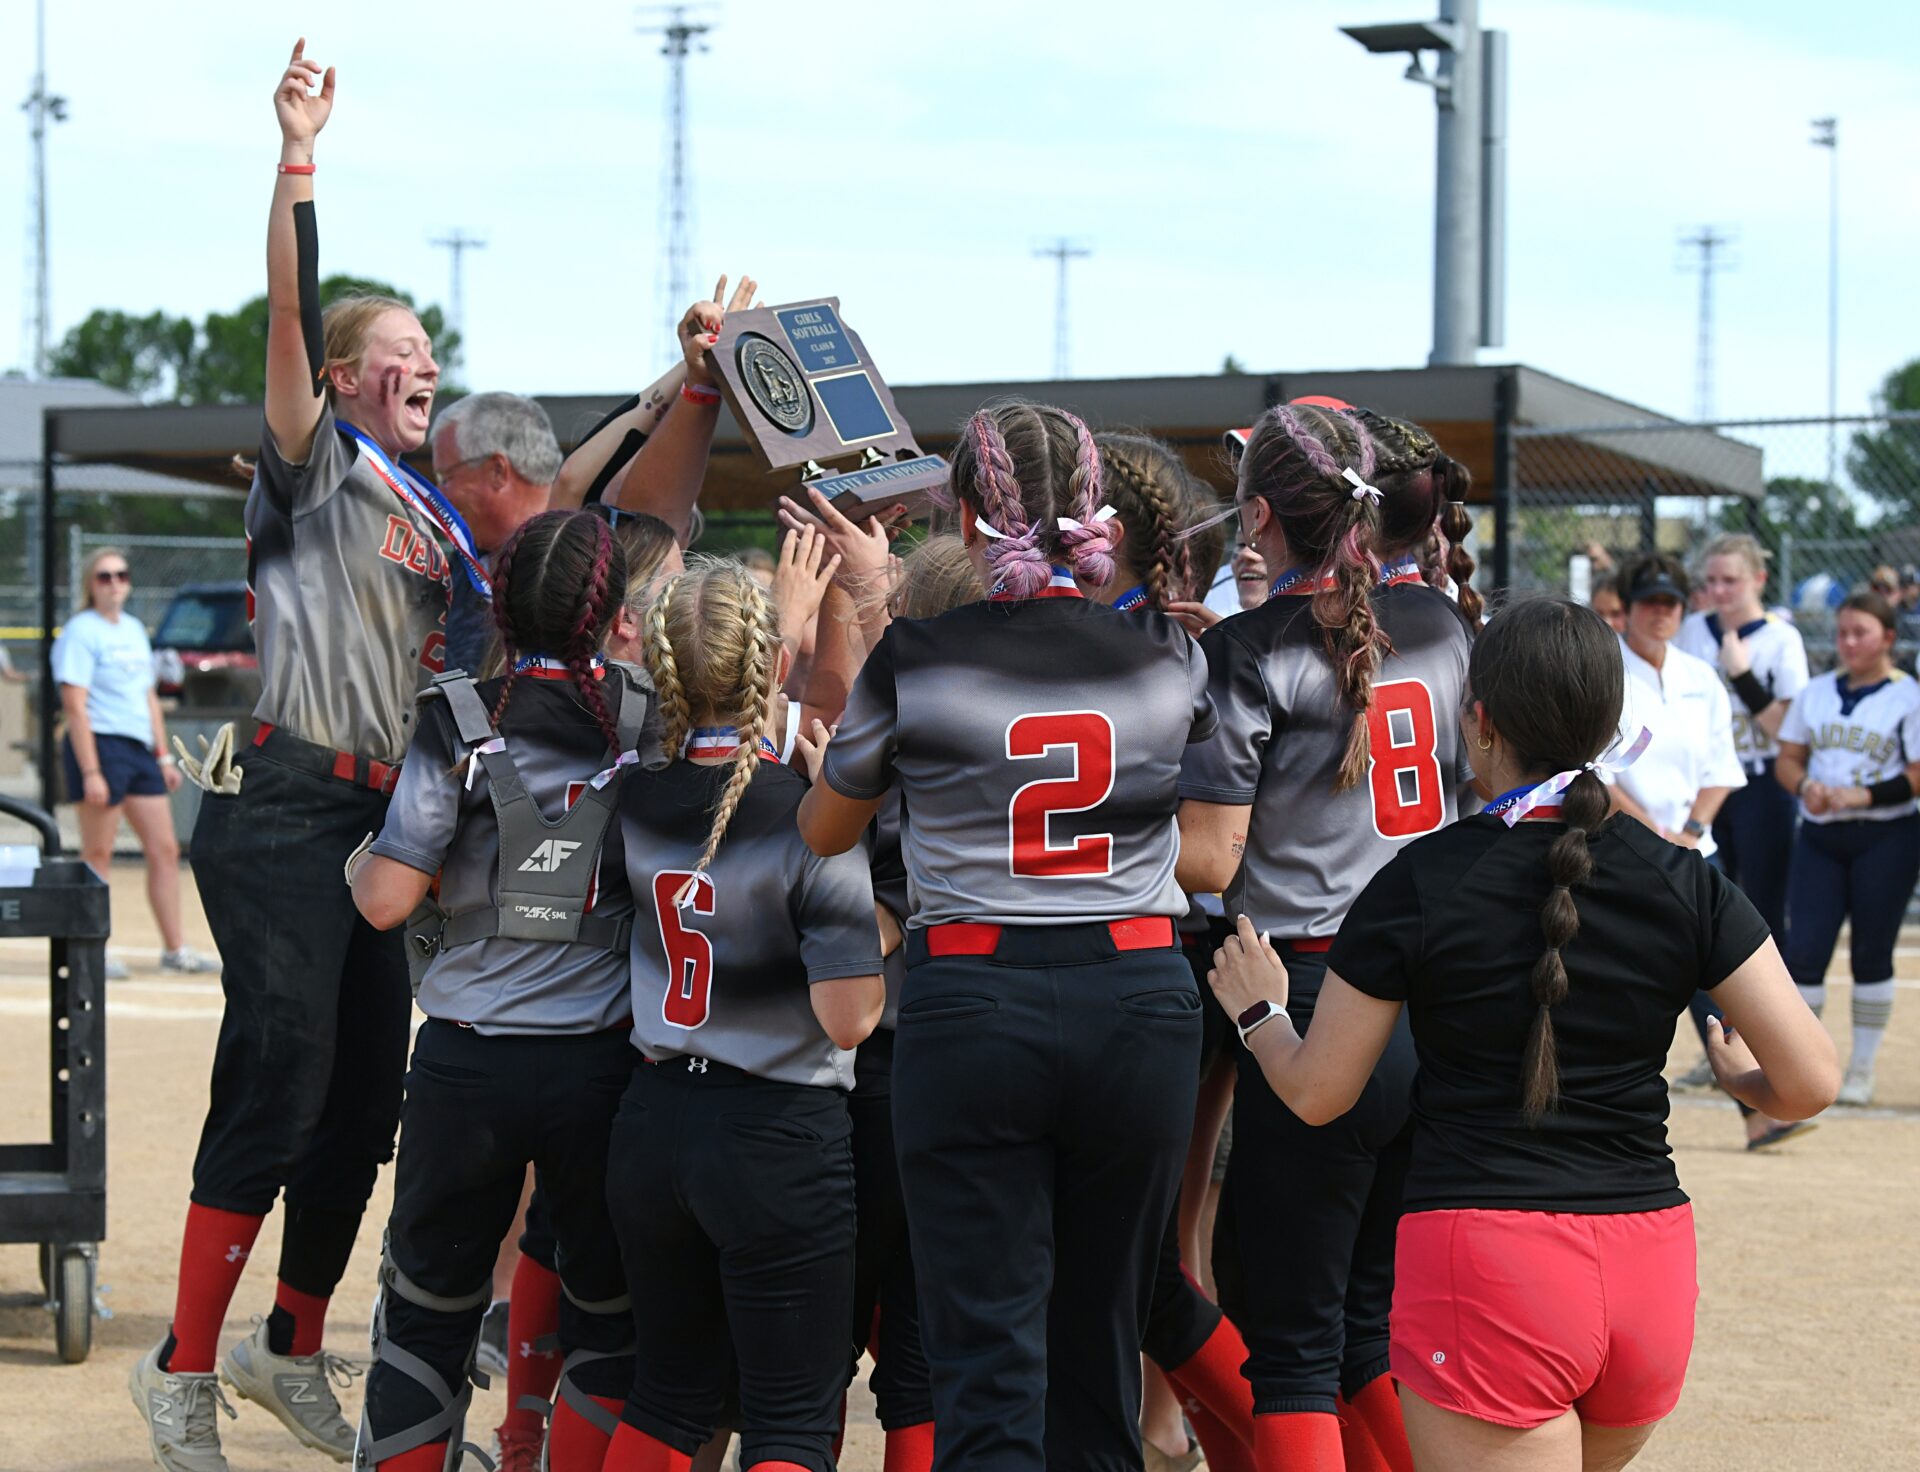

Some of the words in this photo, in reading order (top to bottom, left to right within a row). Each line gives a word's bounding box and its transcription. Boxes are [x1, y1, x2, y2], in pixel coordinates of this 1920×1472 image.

[791, 323, 838, 340] SOFTBALL
[794, 311, 822, 326] GIRLS
[822, 476, 862, 495] STATE
[865, 460, 939, 484] CHAMPIONS
[1366, 677, 1446, 840] 8
[1005, 710, 1116, 879] 2
[517, 839, 583, 872] AF
[652, 870, 716, 1030] 6
